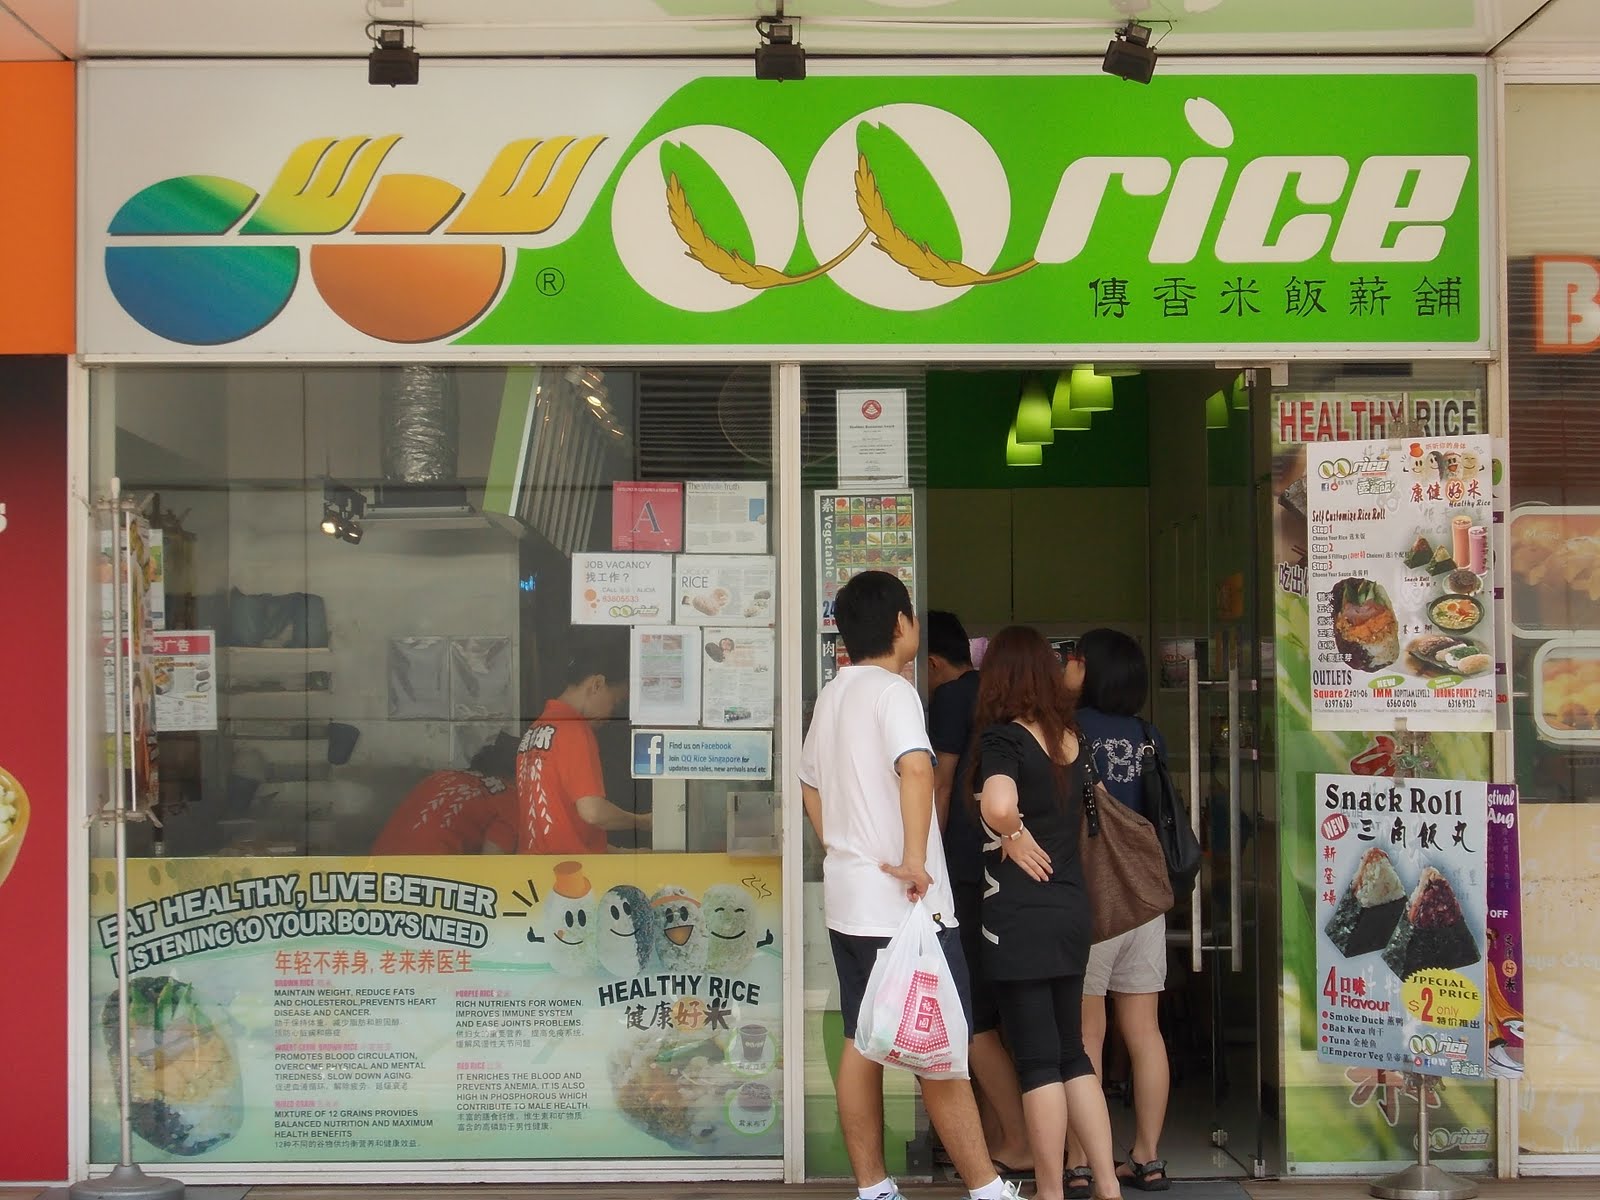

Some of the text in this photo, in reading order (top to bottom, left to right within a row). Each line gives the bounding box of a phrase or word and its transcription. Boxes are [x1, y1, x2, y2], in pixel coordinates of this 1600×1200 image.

[1033, 97, 1471, 264] rice
[1416, 400, 1476, 437] RICE
[688, 482, 700, 491] The
[724, 482, 740, 491] Truth
[1449, 499, 1491, 508] Healthy Rice
[1312, 507, 1386, 524] Self Customize Rice Roll
[1312, 525, 1328, 534] Step
[822, 515, 835, 578] Vegetable
[1312, 543, 1334, 553] Step 2
[585, 560, 652, 569] JOB VACANCY
[1312, 560, 1333, 571] Step 3
[681, 576, 708, 588] RICE
[823, 641, 834, 657] 肉
[1313, 670, 1353, 686] OUTLETS
[1376, 678, 1396, 688] NEW
[1313, 689, 1343, 700] Square
[1373, 688, 1392, 698] IMM
[1456, 688, 1473, 698] POINT
[669, 742, 683, 750] Find
[701, 742, 731, 750] Facebook
[693, 755, 707, 763] Rice
[708, 755, 741, 764] Singapore
[669, 765, 690, 773] updates
[726, 765, 746, 773] arrivals
[747, 765, 756, 773] and
[1325, 783, 1462, 816] Snack Roll
[1487, 807, 1515, 829] Aug
[1323, 815, 1348, 839] NEW
[310, 872, 378, 902] LIVE
[382, 873, 498, 919] BETTER
[1489, 909, 1509, 919] OFF
[264, 908, 334, 942] YOUR
[335, 909, 422, 936] BODY'S
[422, 914, 488, 949] NEED
[1323, 966, 1366, 1006] 4 口味
[1412, 975, 1466, 989] SPECIAL
[274, 988, 415, 997] MAINTAIN REDUCE FATS
[598, 975, 761, 1006] HEALTHY RICE
[1439, 989, 1479, 1000] PRICE
[274, 999, 292, 1007] AND
[407, 998, 437, 1006] HEART
[456, 1000, 476, 1008] RICH
[1340, 994, 1390, 1012] Flavour
[274, 1009, 310, 1017] DISEASE
[456, 1010, 500, 1018] IMPROVES
[538, 1009, 573, 1017] SYSTEM
[624, 997, 731, 1031] 健康好米
[1436, 1004, 1459, 1017] only
[1329, 1012, 1384, 1025] Smoke Duck
[456, 1020, 474, 1028] AND
[476, 1020, 499, 1028] EASE
[1329, 1023, 1365, 1035] Bak Kwa
[1329, 1035, 1351, 1045] Tuna
[1329, 1047, 1384, 1062] Emperor Veg
[275, 1063, 324, 1071] OVERCOME
[391, 1062, 426, 1070] MENTAL
[466, 1073, 510, 1081] ENRICHES
[563, 1072, 582, 1080] AND
[457, 1083, 501, 1091] PREVENTS
[457, 1093, 478, 1101] HIGH
[457, 1103, 512, 1111] CONTRIBUTE
[275, 1120, 322, 1128] BALANCED
[392, 1119, 434, 1127] MAXIMUM
[275, 1130, 353, 1138] HEALTH BENEFITS
